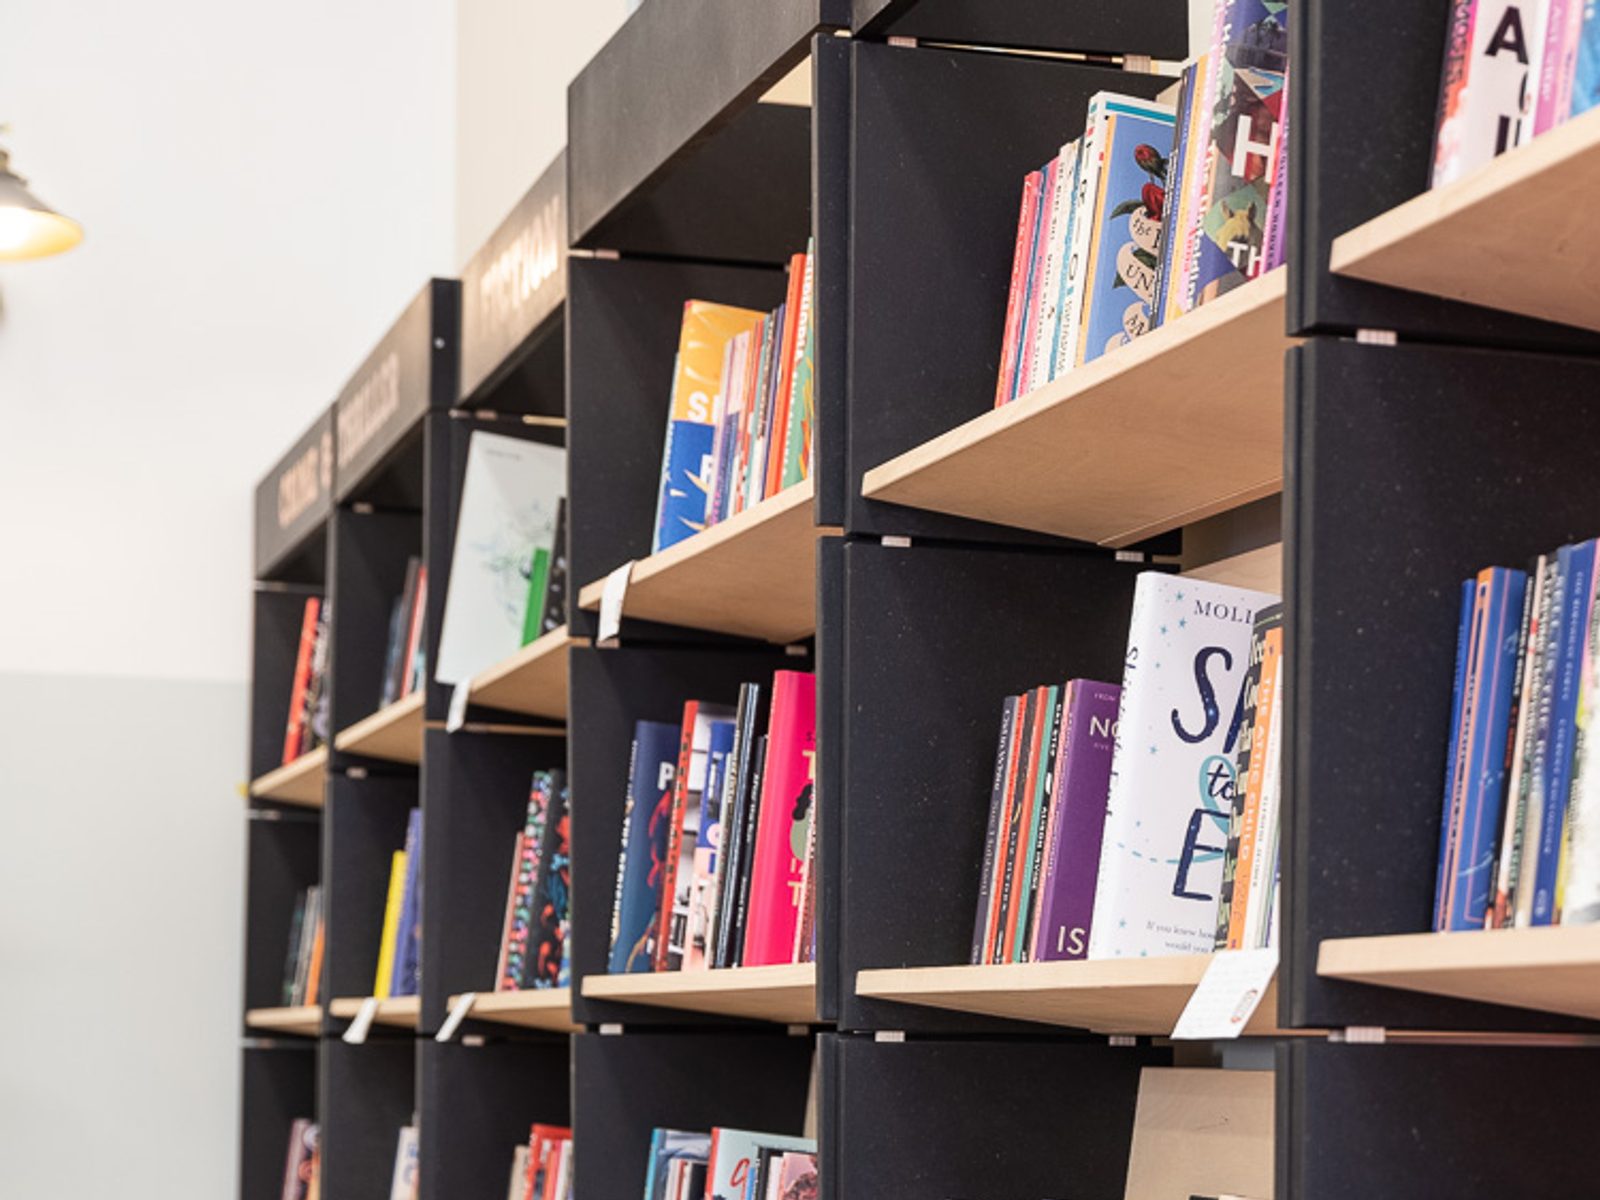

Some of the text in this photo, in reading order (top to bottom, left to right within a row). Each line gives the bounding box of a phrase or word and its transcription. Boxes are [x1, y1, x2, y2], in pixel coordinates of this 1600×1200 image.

[1257, 675, 1271, 716] THE
[1249, 725, 1265, 785] ATTIC
[1240, 793, 1257, 862] CHILD
